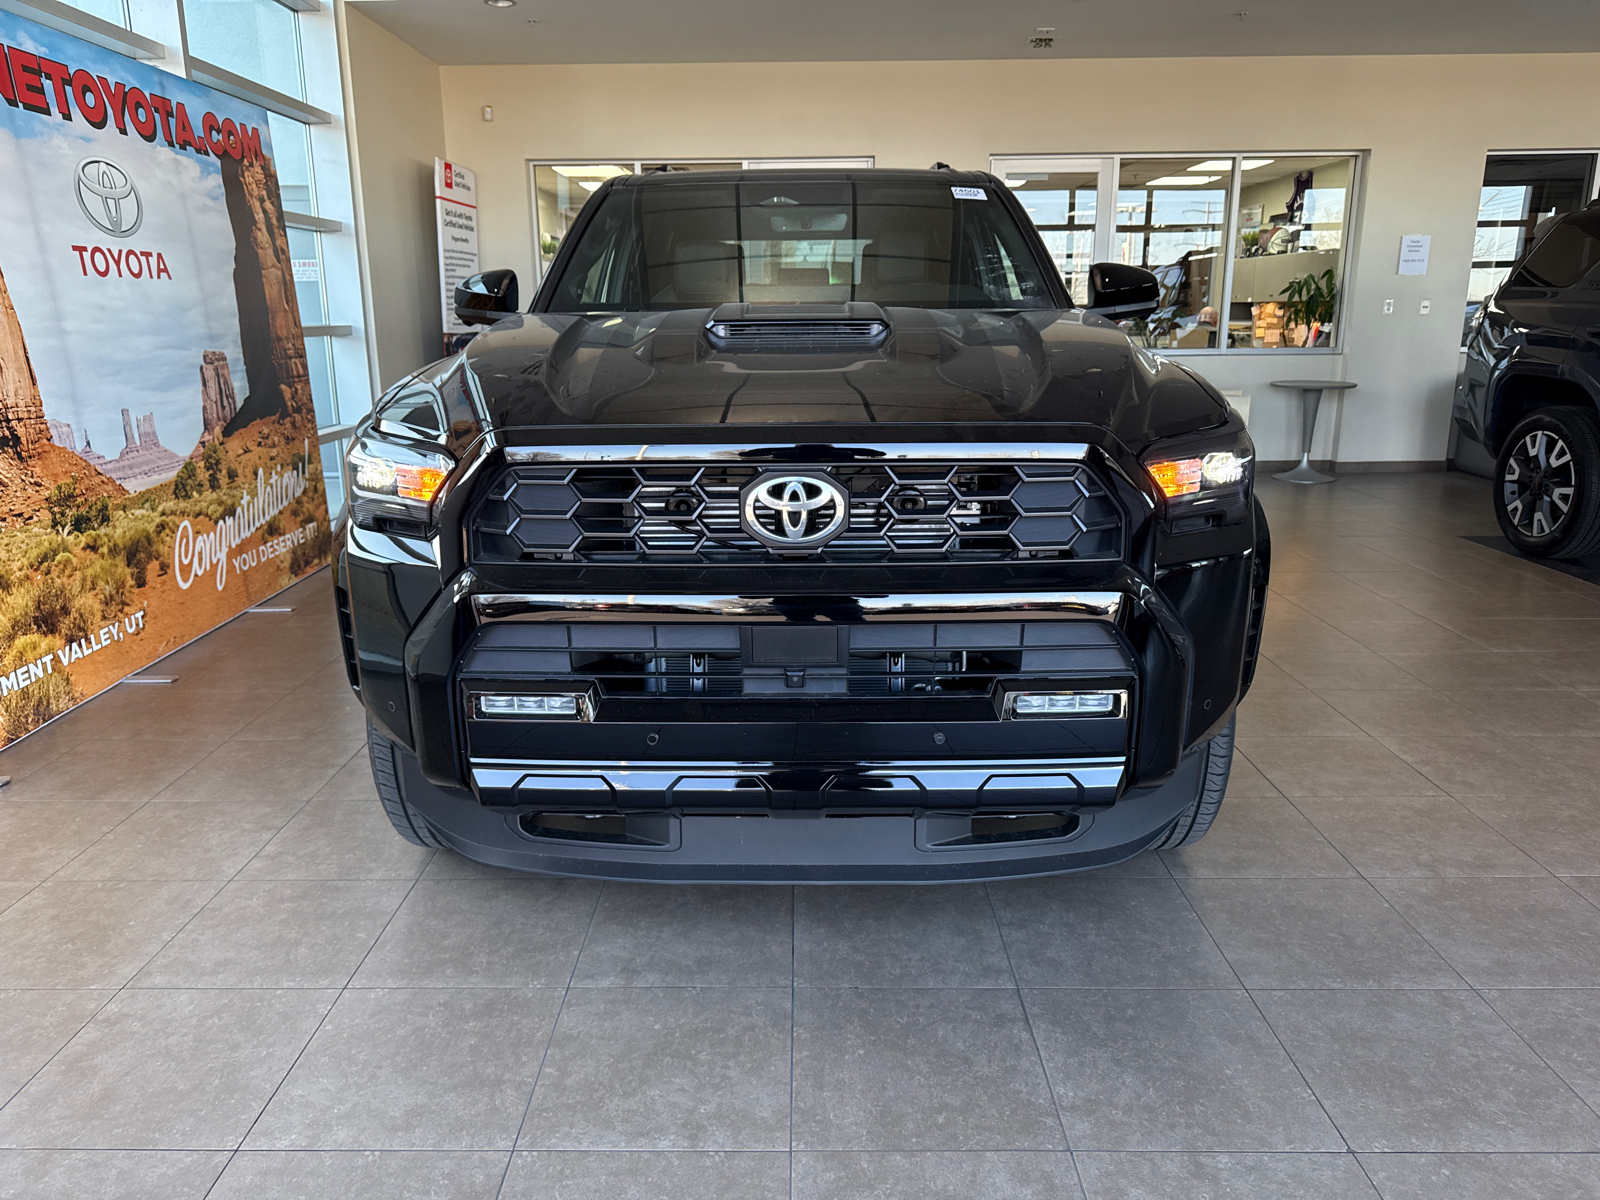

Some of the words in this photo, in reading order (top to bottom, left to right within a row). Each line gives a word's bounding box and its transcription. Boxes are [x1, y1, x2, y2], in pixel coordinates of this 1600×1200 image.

[71, 245, 172, 280] TOYOTA
[174, 437, 309, 592] Congratulations!
[232, 550, 257, 574] YOU
[258, 528, 305, 563] DESERVE
[305, 521, 318, 541] IT!
[0, 653, 54, 698] MENT
[56, 622, 124, 667] VALLEY,
[124, 610, 145, 634] UT
